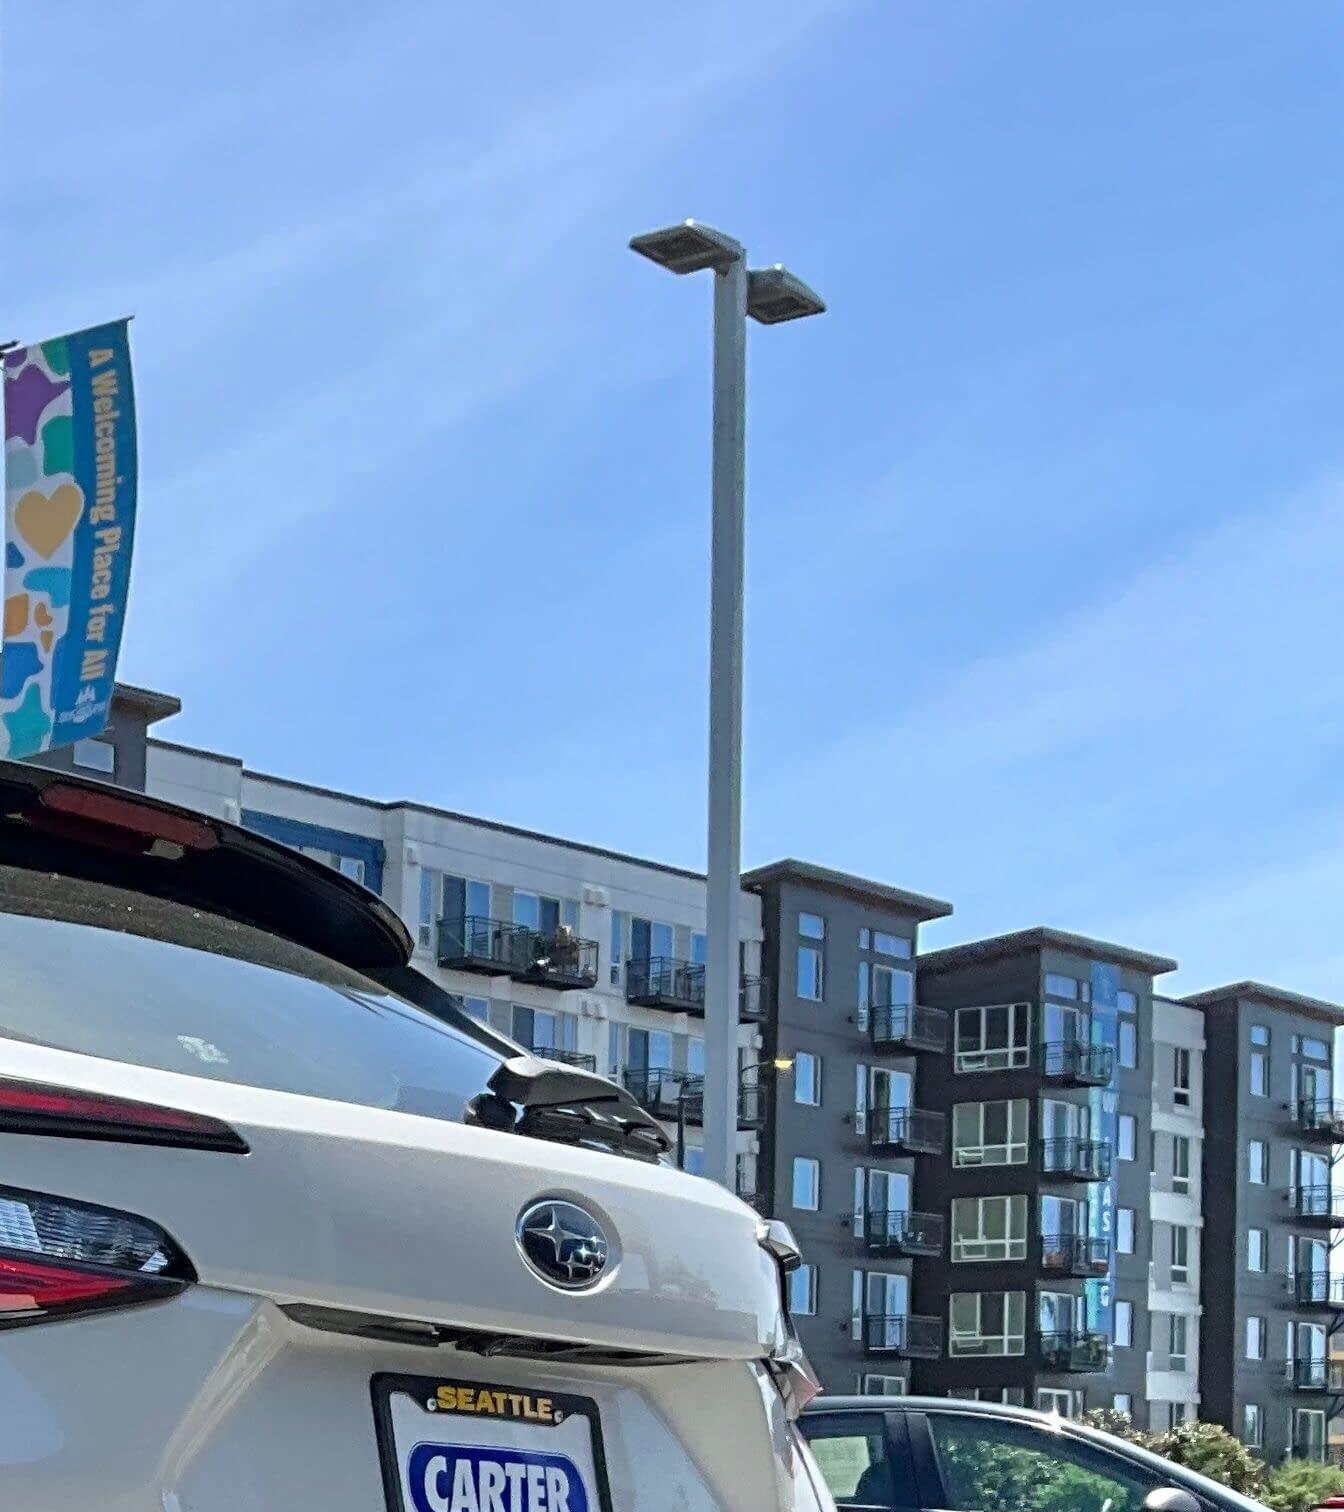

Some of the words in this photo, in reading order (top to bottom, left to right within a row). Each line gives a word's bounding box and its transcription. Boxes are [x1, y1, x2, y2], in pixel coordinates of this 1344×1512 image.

[88, 349, 114, 368] A
[89, 369, 123, 525] Welcoming
[91, 526, 122, 600] Place
[86, 603, 115, 642] for
[80, 649, 109, 682] All
[435, 1385, 553, 1420] SEATTLE
